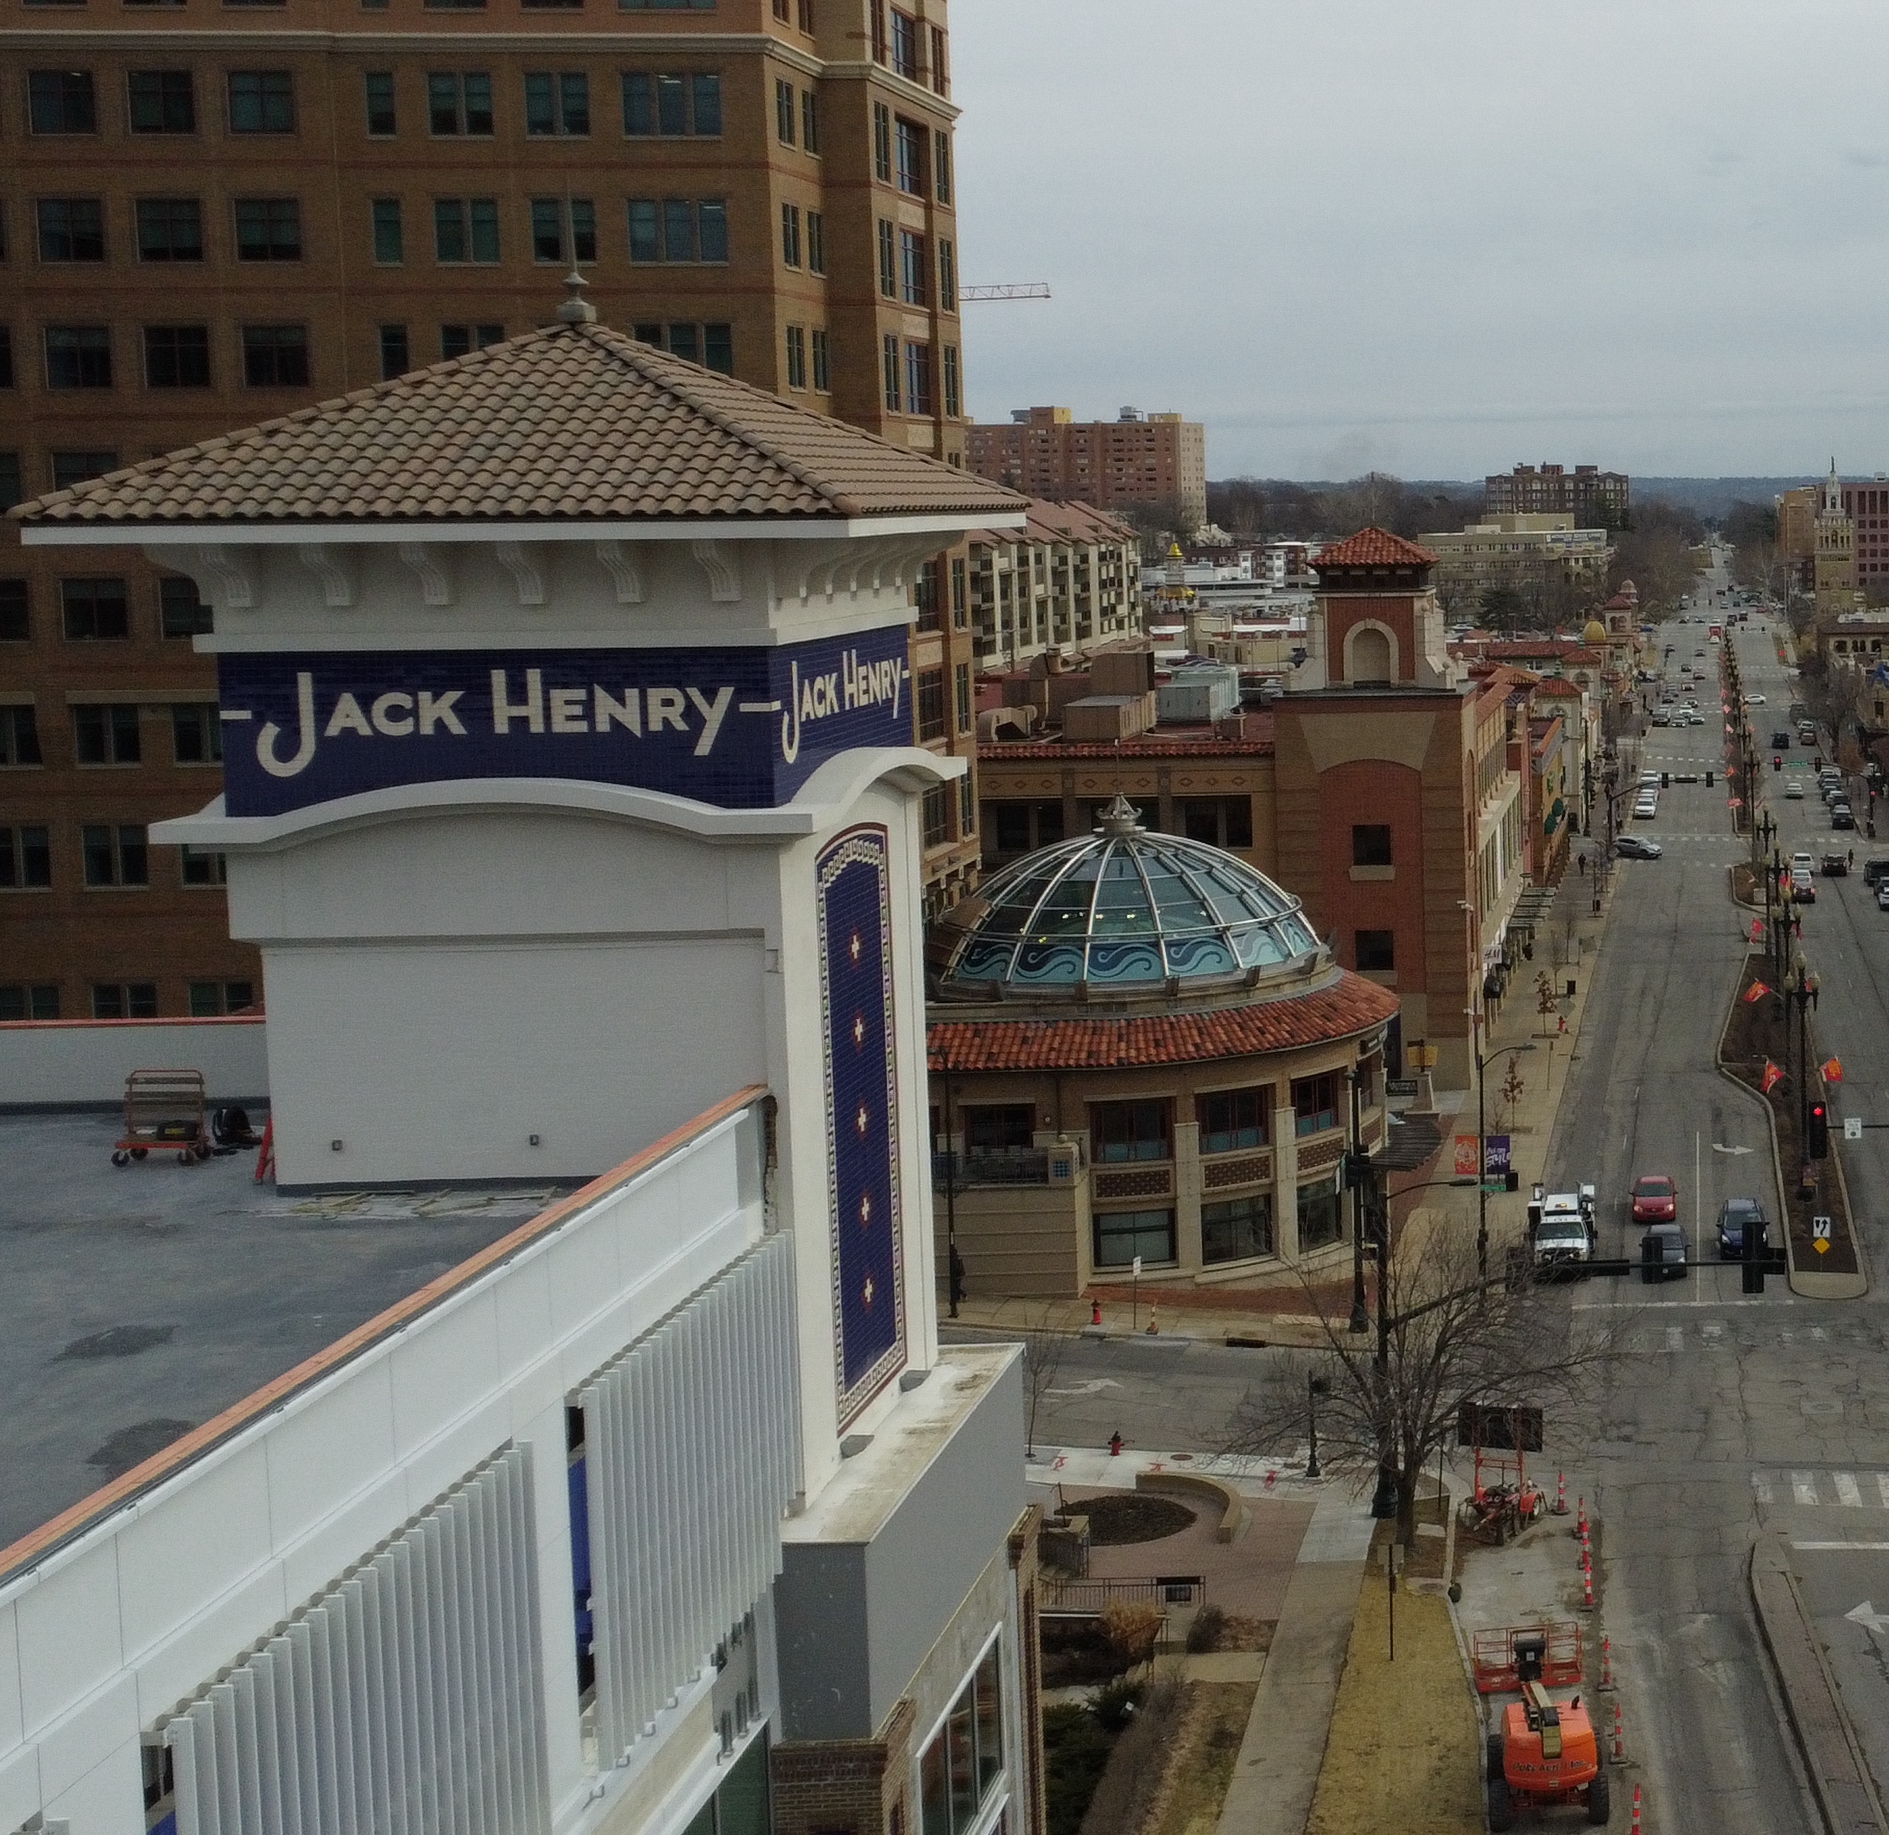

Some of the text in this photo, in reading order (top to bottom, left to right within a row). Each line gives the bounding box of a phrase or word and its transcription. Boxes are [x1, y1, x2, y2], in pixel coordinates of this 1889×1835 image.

[256, 668, 735, 777] JACK HENRY
[782, 648, 902, 764] JACK HENRY
